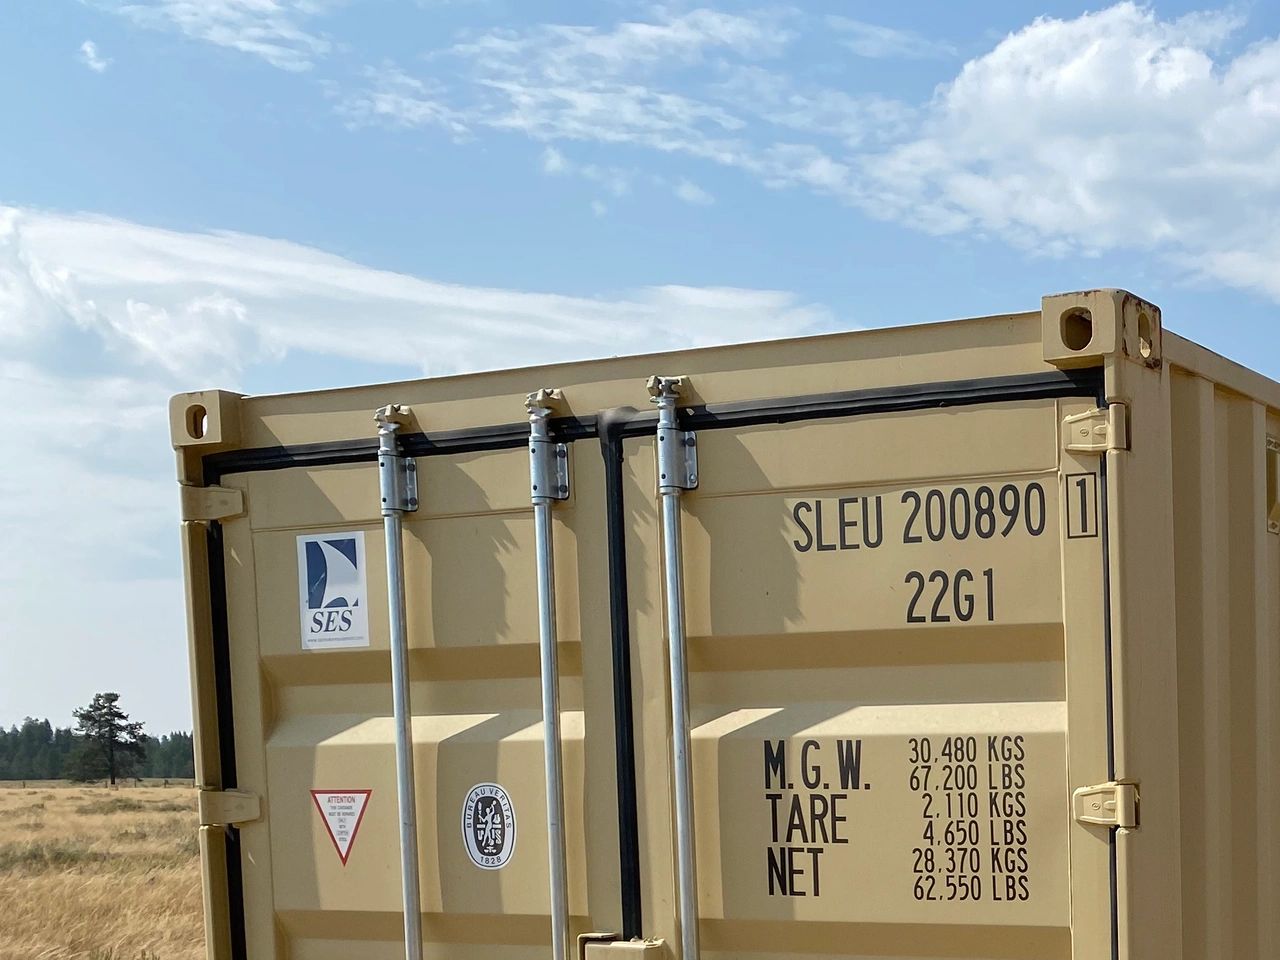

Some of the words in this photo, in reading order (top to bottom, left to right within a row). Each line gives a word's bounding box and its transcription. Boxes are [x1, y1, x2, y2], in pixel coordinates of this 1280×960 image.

[793, 496, 883, 552] SLEU
[900, 482, 1046, 544] 200890
[1076, 478, 1088, 533] 1
[904, 568, 994, 623] 22G1
[310, 609, 353, 633] SES
[908, 736, 977, 763] 30,480
[988, 735, 1025, 762] KGS
[764, 739, 871, 790] M.G.W.
[909, 765, 977, 791] 67,200
[988, 764, 1025, 790] LBS
[466, 788, 486, 828] BUREAU
[489, 788, 512, 829] VERITAS
[765, 793, 849, 843] TARE
[922, 792, 978, 818] 2,110
[989, 792, 1026, 818] KGS
[923, 820, 980, 846] 4,650
[990, 820, 1028, 846] LBS
[480, 856, 502, 865] 1828
[767, 847, 824, 897] NET
[912, 848, 981, 874] 28,370
[991, 848, 1029, 874] KGS
[913, 875, 982, 901] 62,550
[992, 875, 1030, 901] LBS
